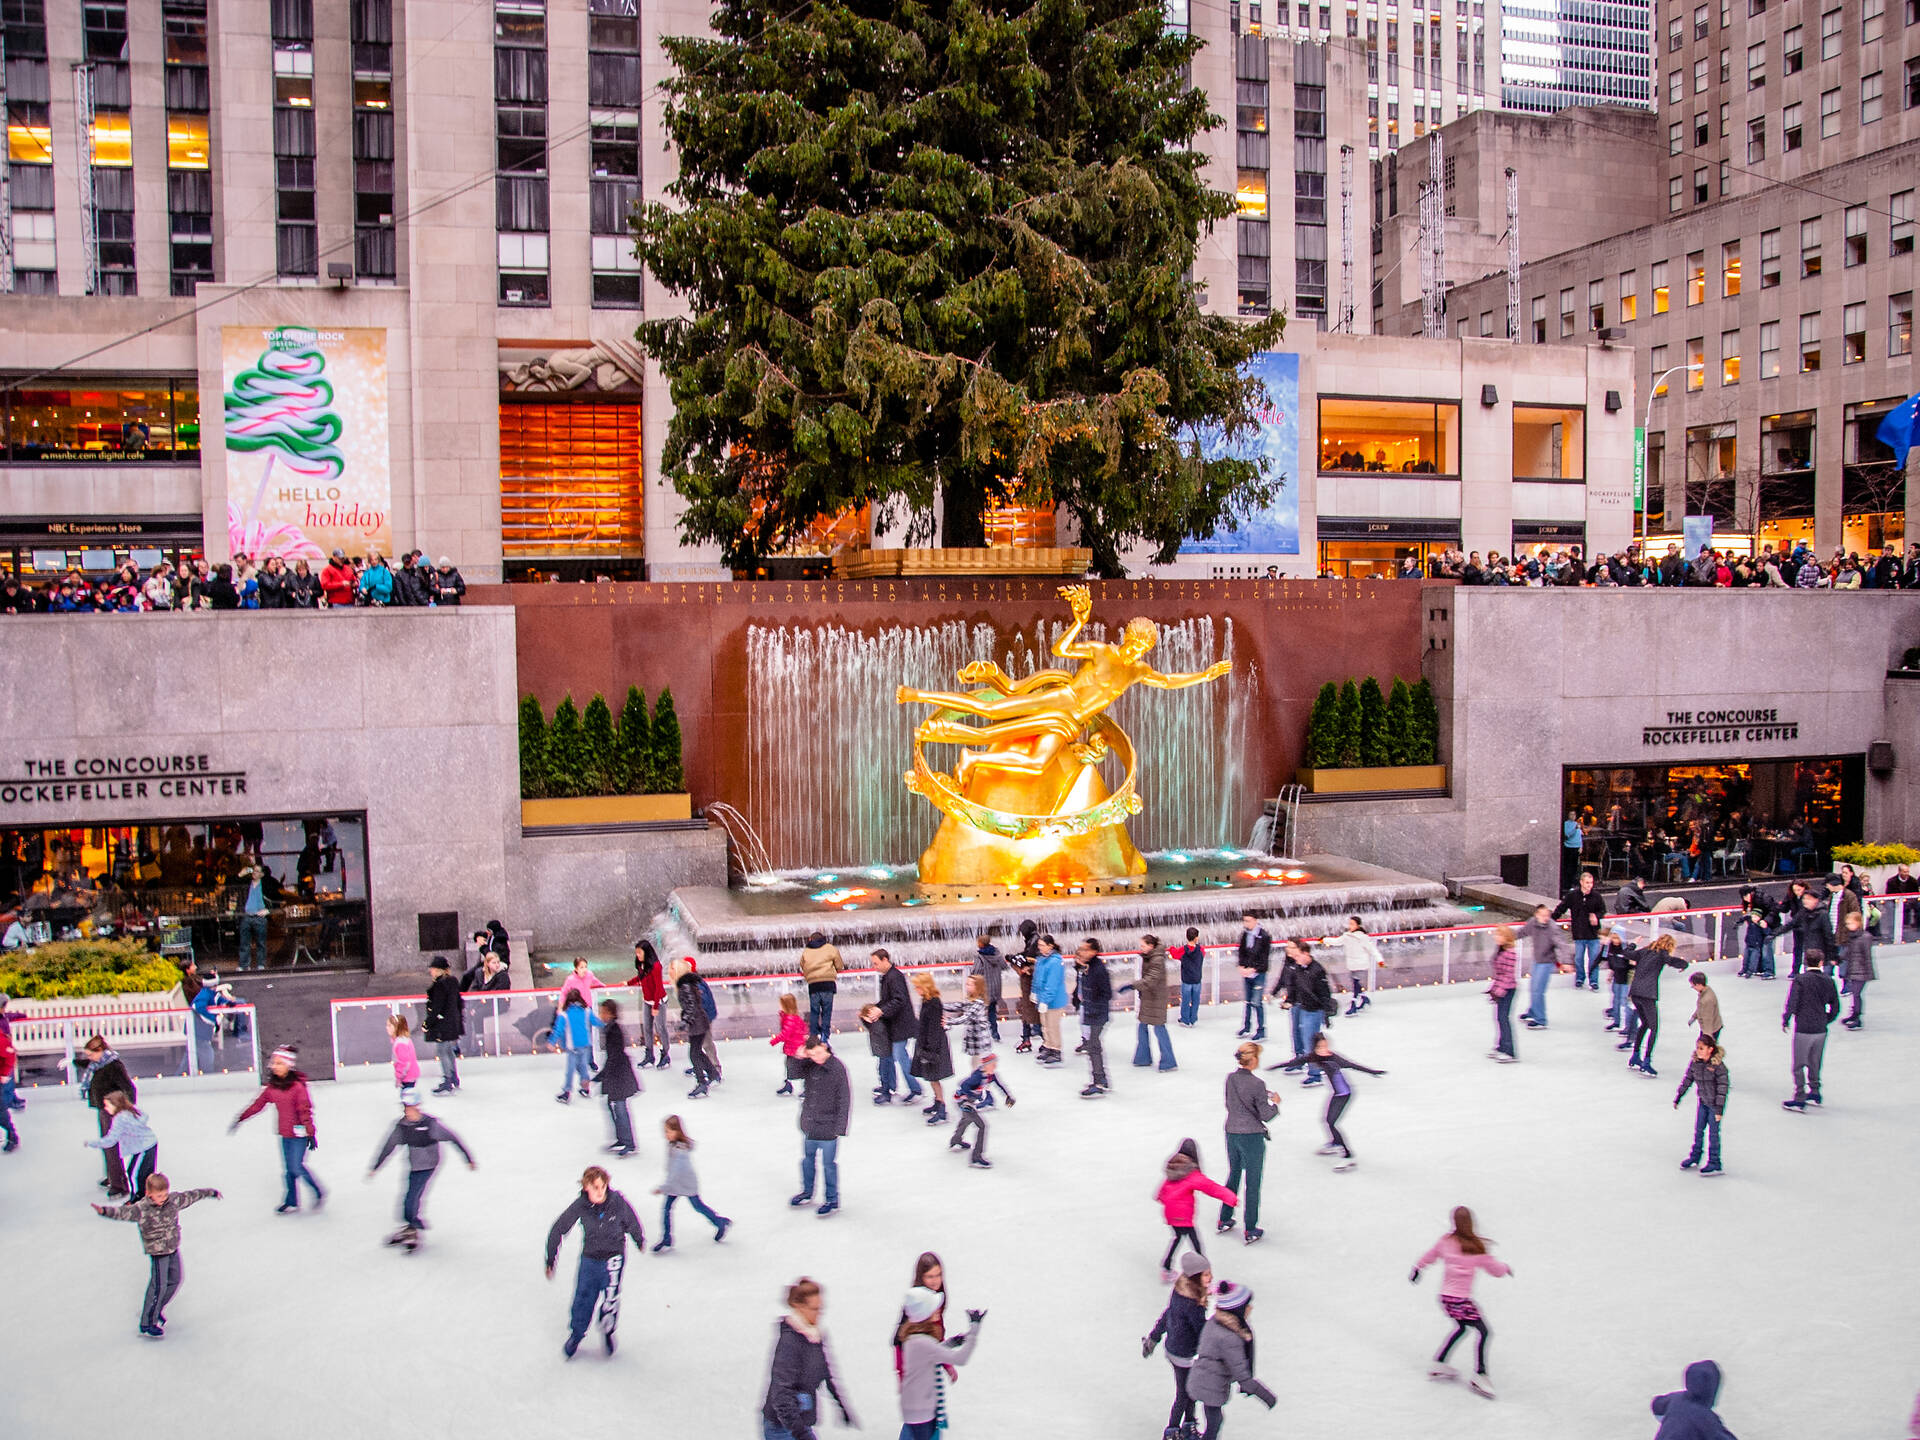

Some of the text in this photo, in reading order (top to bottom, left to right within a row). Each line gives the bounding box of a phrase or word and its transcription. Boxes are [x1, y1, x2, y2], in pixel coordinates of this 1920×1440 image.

[262, 330, 282, 341] TOP
[318, 332, 345, 341] ROCK
[50, 451, 97, 460] msnbc.com
[98, 451, 126, 462] digital
[1634, 466, 1642, 498] HELLO
[278, 487, 341, 501] HELLO
[305, 503, 384, 536] holiday
[48, 524, 142, 534] NBC Experience Store
[591, 583, 1045, 594] PROMETHEUS TEACHER IN EVERY
[1132, 582, 1230, 590] BROUGHT
[574, 595, 633, 604] THAT
[662, 595, 722, 604] HATH
[751, 594, 844, 604] PROVED
[872, 593, 896, 602] TO
[921, 593, 1028, 601] MORTALS
[1179, 591, 1200, 600] TO
[1223, 591, 1303, 600] MIGHTY
[1327, 591, 1376, 600] ENDS
[1667, 709, 1778, 724] THE CONCOURSE
[1642, 727, 1799, 746] ROCKEFELLER CENTER
[24, 755, 210, 776] THE CONCOURSE
[0, 779, 247, 804] OCKEFELLER CENTER
